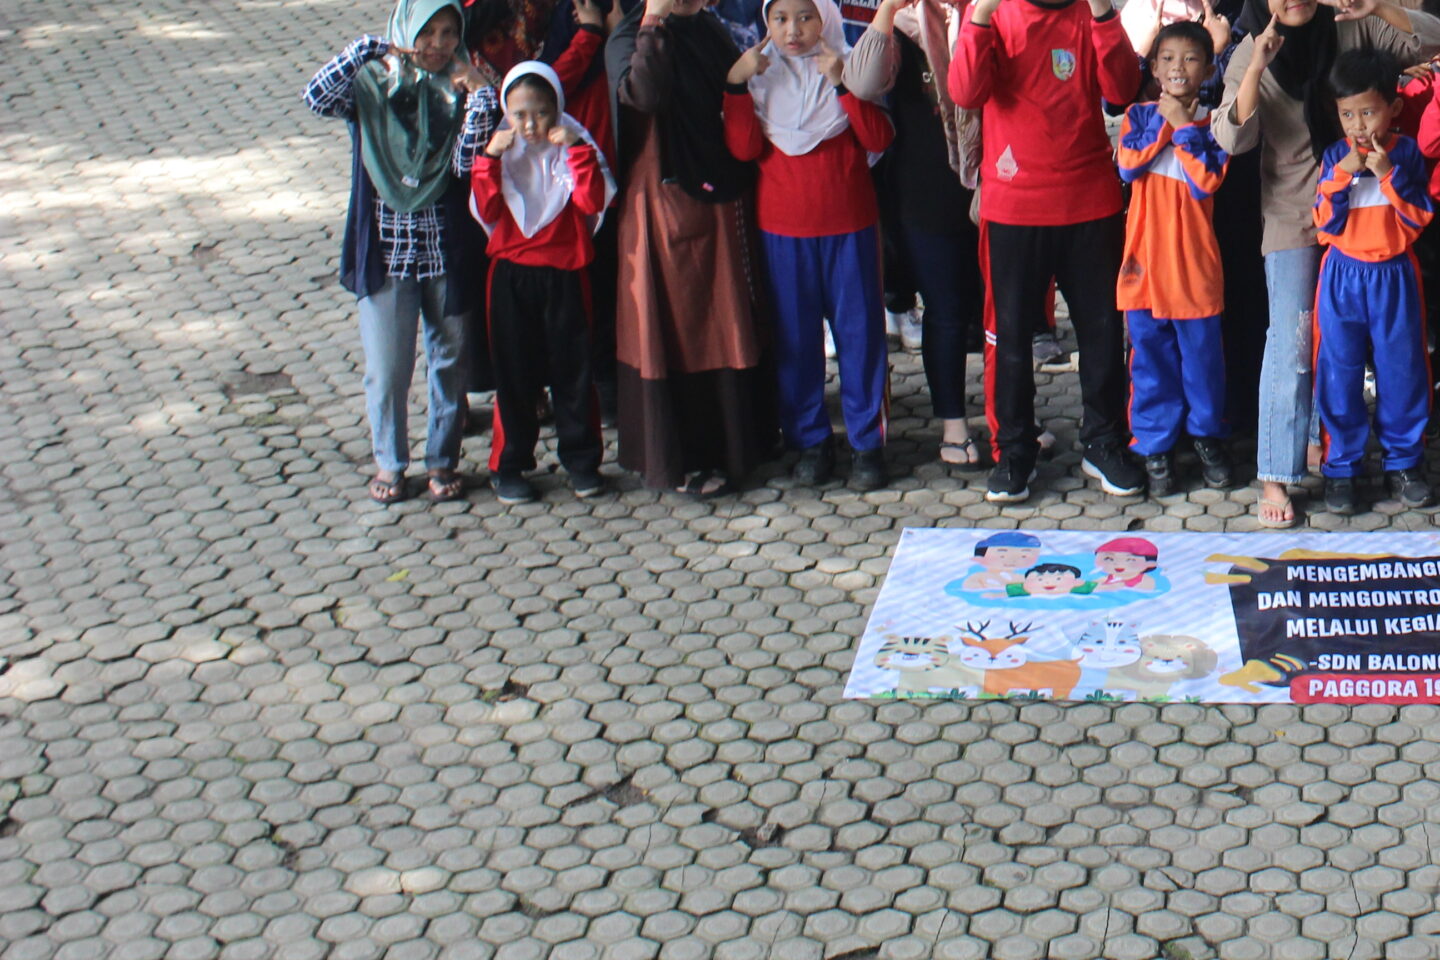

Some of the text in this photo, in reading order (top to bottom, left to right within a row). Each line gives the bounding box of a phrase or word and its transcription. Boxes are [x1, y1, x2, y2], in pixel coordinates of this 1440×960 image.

[1257, 591, 1301, 610] DAN
[1286, 618, 1378, 638] MELALUI
[1309, 679, 1418, 697] PAGGORA
